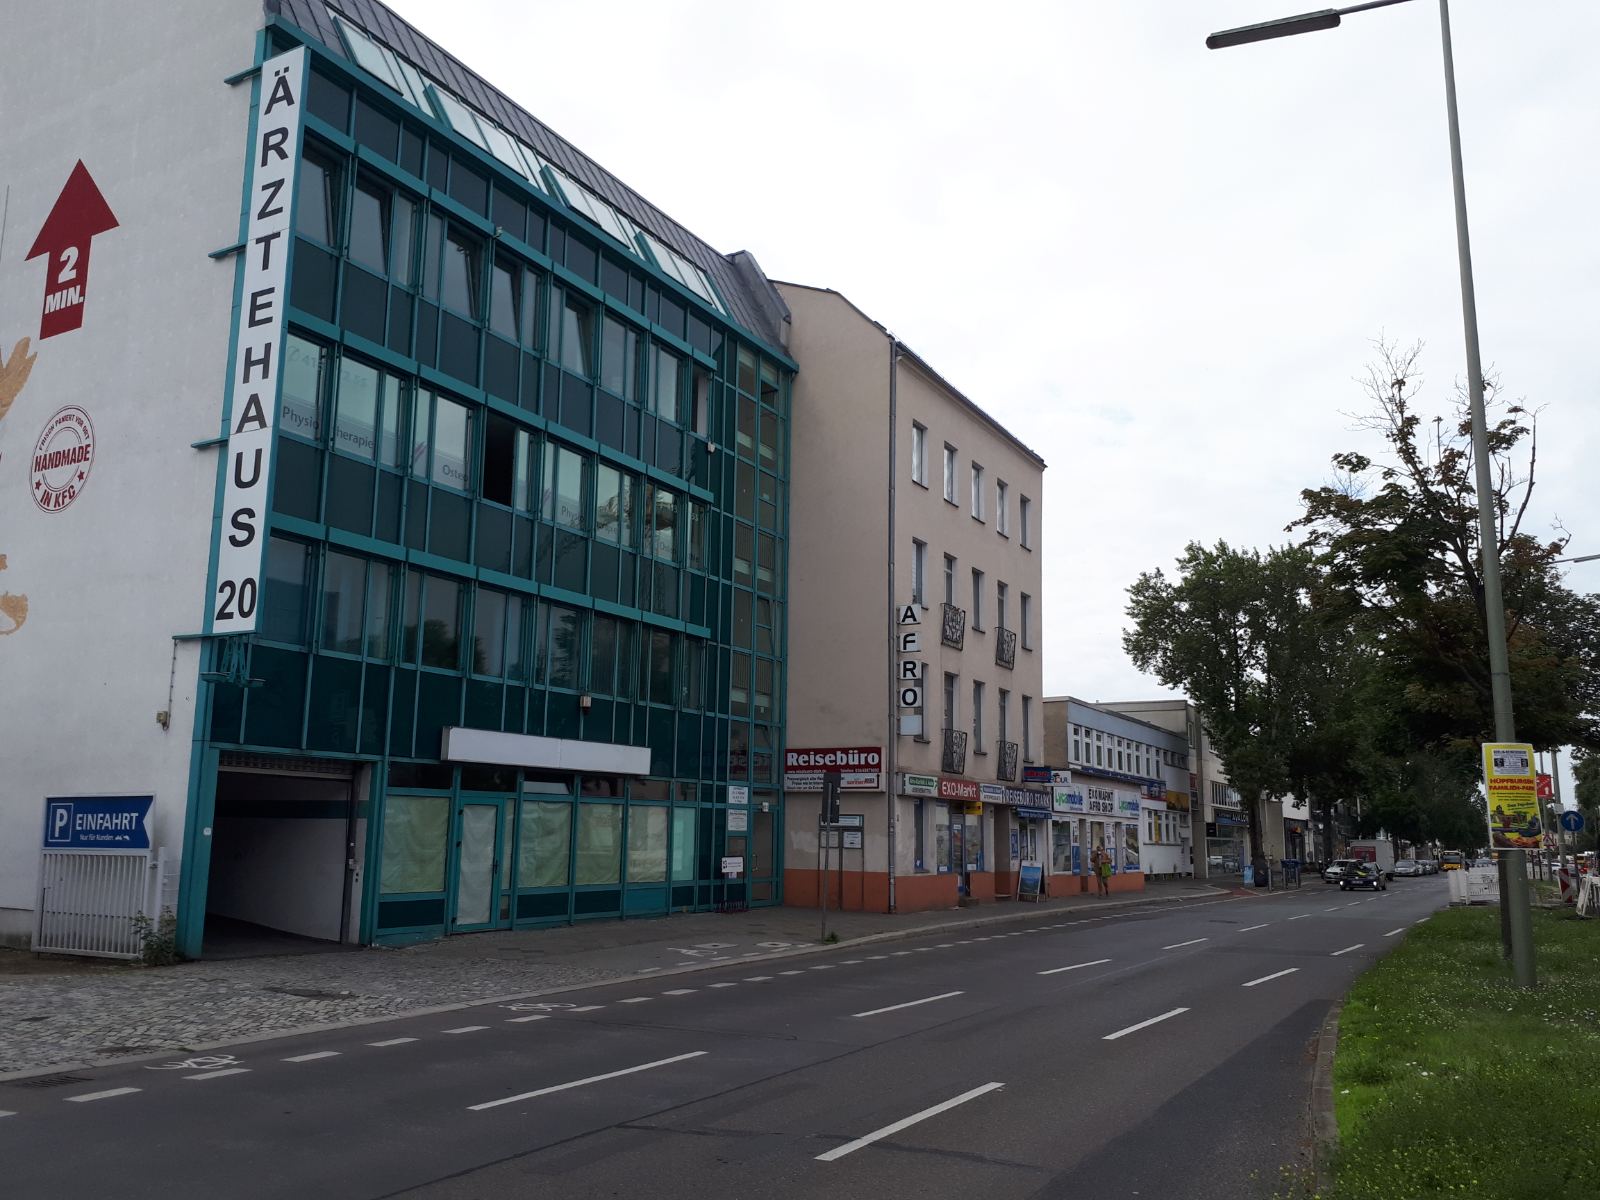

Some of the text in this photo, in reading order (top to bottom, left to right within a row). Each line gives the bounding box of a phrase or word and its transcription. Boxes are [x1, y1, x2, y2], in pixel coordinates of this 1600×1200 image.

[57, 246, 79, 284] 2
[44, 285, 84, 315] MIN.
[215, 65, 295, 621] ÄRZTEHAUS 20
[55, 414, 76, 427] PANIERT
[75, 415, 84, 428] VOR
[82, 425, 90, 440] ORT
[34, 443, 92, 473] HANDMADE
[40, 484, 76, 508] IN KFC
[901, 605, 918, 706] AFRO
[787, 749, 880, 766] Reisebüro
[941, 781, 978, 798] EXO-Markt
[1089, 801, 1101, 812] AFRO
[1101, 802, 1114, 813] SHOP
[54, 808, 139, 838] P EINFAHRT
